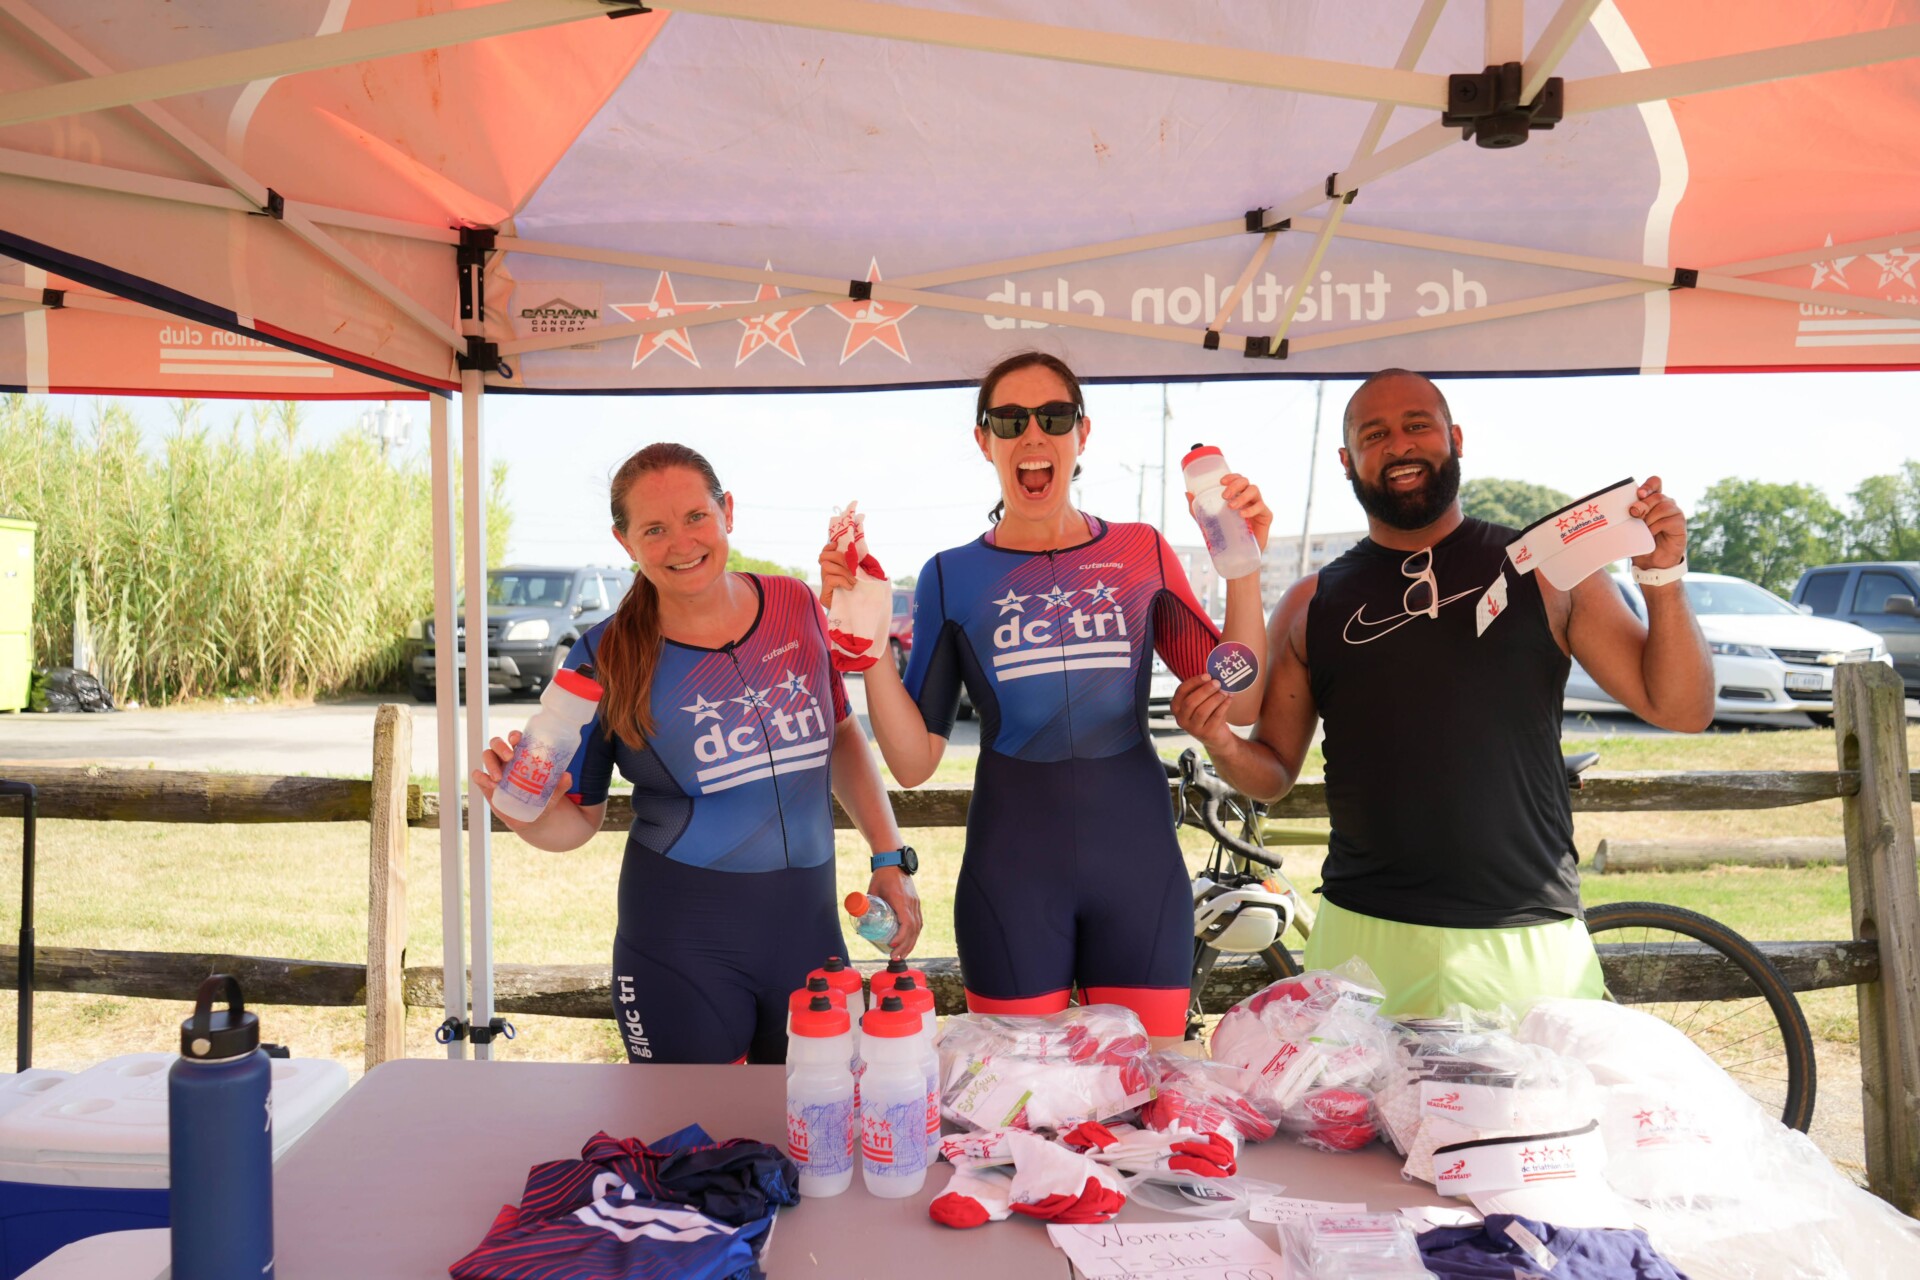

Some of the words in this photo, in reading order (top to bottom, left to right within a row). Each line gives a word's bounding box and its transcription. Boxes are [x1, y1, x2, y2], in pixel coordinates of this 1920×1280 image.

[521, 308, 598, 319] CARAVAN
[1078, 561, 1124, 570] cutaway
[993, 615, 1053, 649] dc
[1068, 605, 1128, 639] tri
[762, 639, 799, 662] cutaway
[1220, 667, 1234, 679] dc
[1232, 656, 1248, 670] tri
[693, 723, 760, 763] dc
[770, 697, 827, 742] tri
[513, 760, 528, 777] dc
[531, 770, 550, 785] tri
[617, 975, 636, 1004] tri
[625, 1009, 644, 1037] dc
[927, 1105, 938, 1120] dc
[792, 1128, 808, 1148] tri
[873, 1132, 893, 1149] tri
